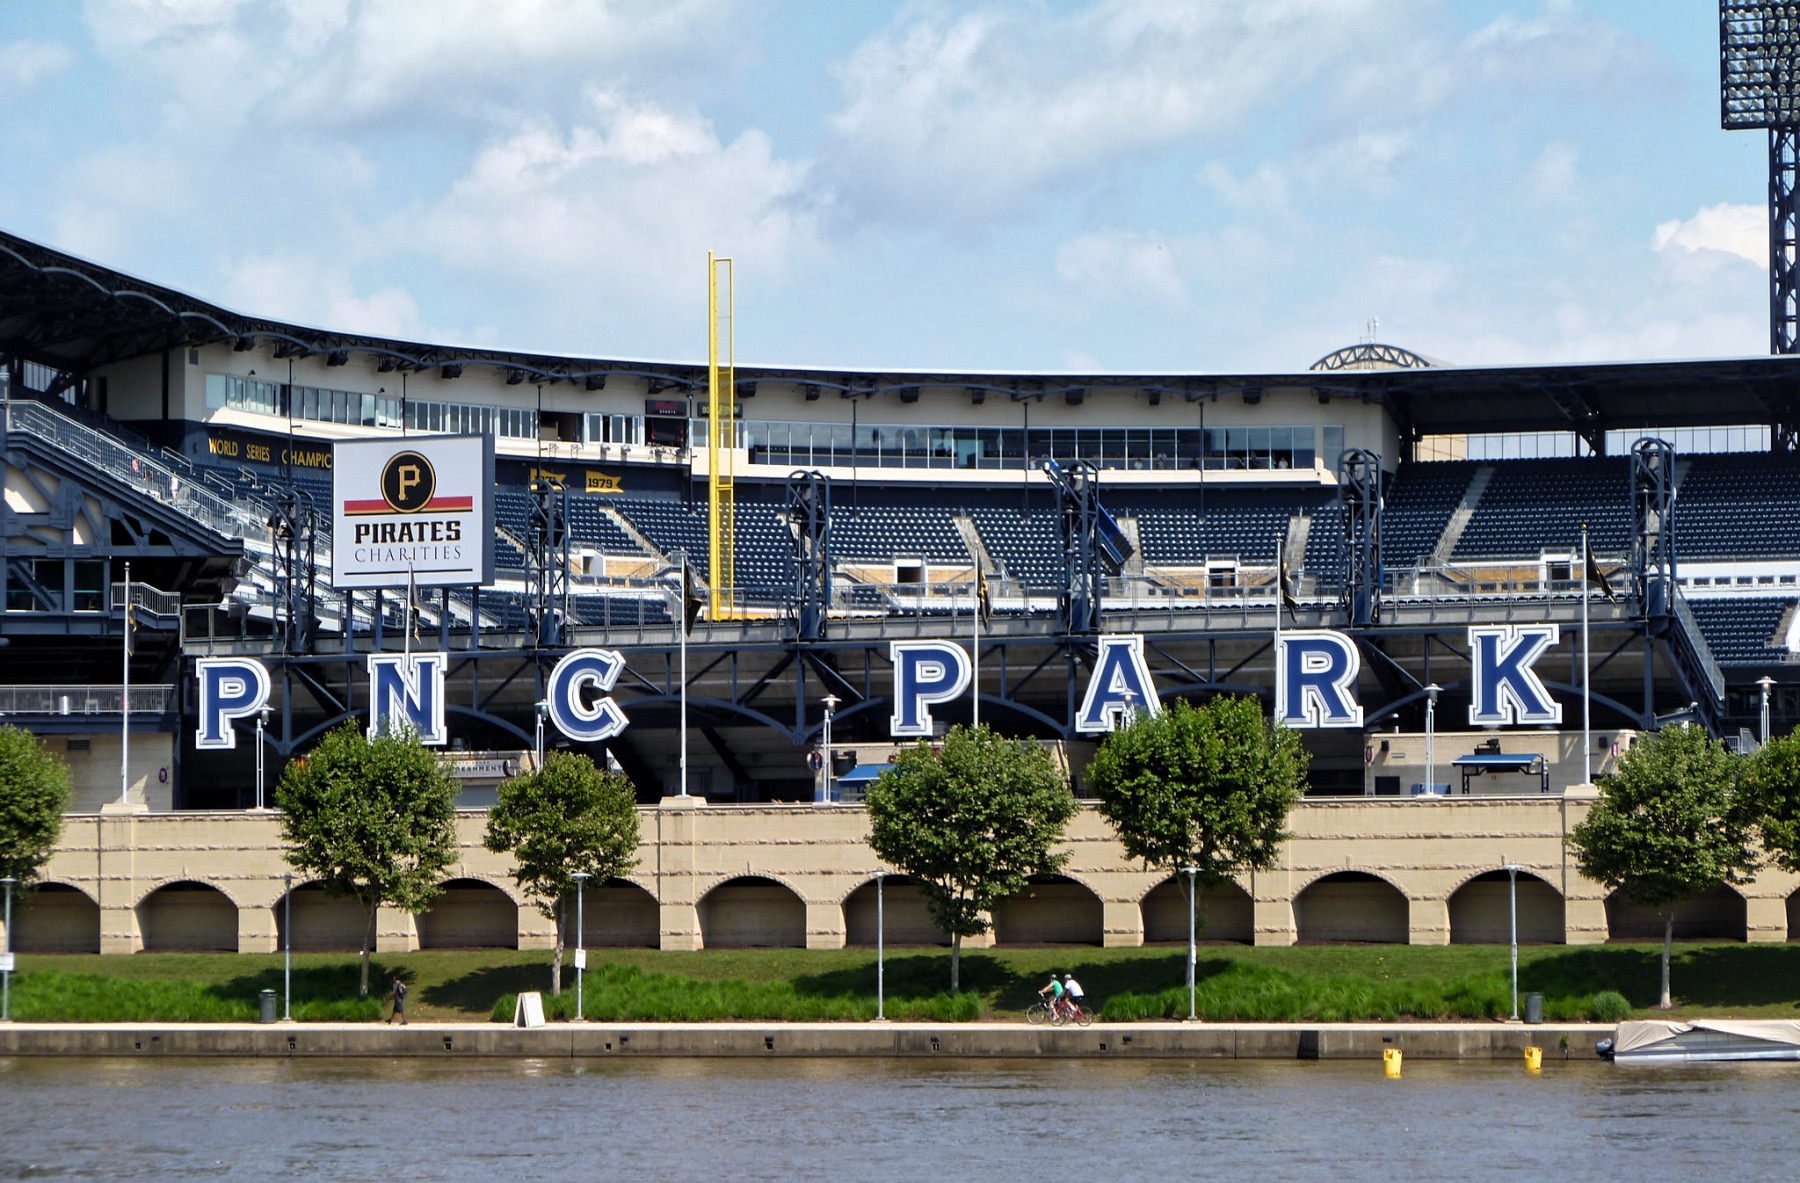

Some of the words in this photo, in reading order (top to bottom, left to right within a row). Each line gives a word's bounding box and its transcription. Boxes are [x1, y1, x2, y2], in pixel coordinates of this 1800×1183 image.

[208, 437, 239, 457] WORLD
[246, 443, 271, 462] SERIES
[398, 464, 420, 501] P
[588, 478, 613, 489] 1979
[354, 520, 461, 544] PIRATES
[354, 545, 461, 563] CHARITIES
[196, 648, 629, 749] PNC
[890, 624, 1562, 736] PARK
